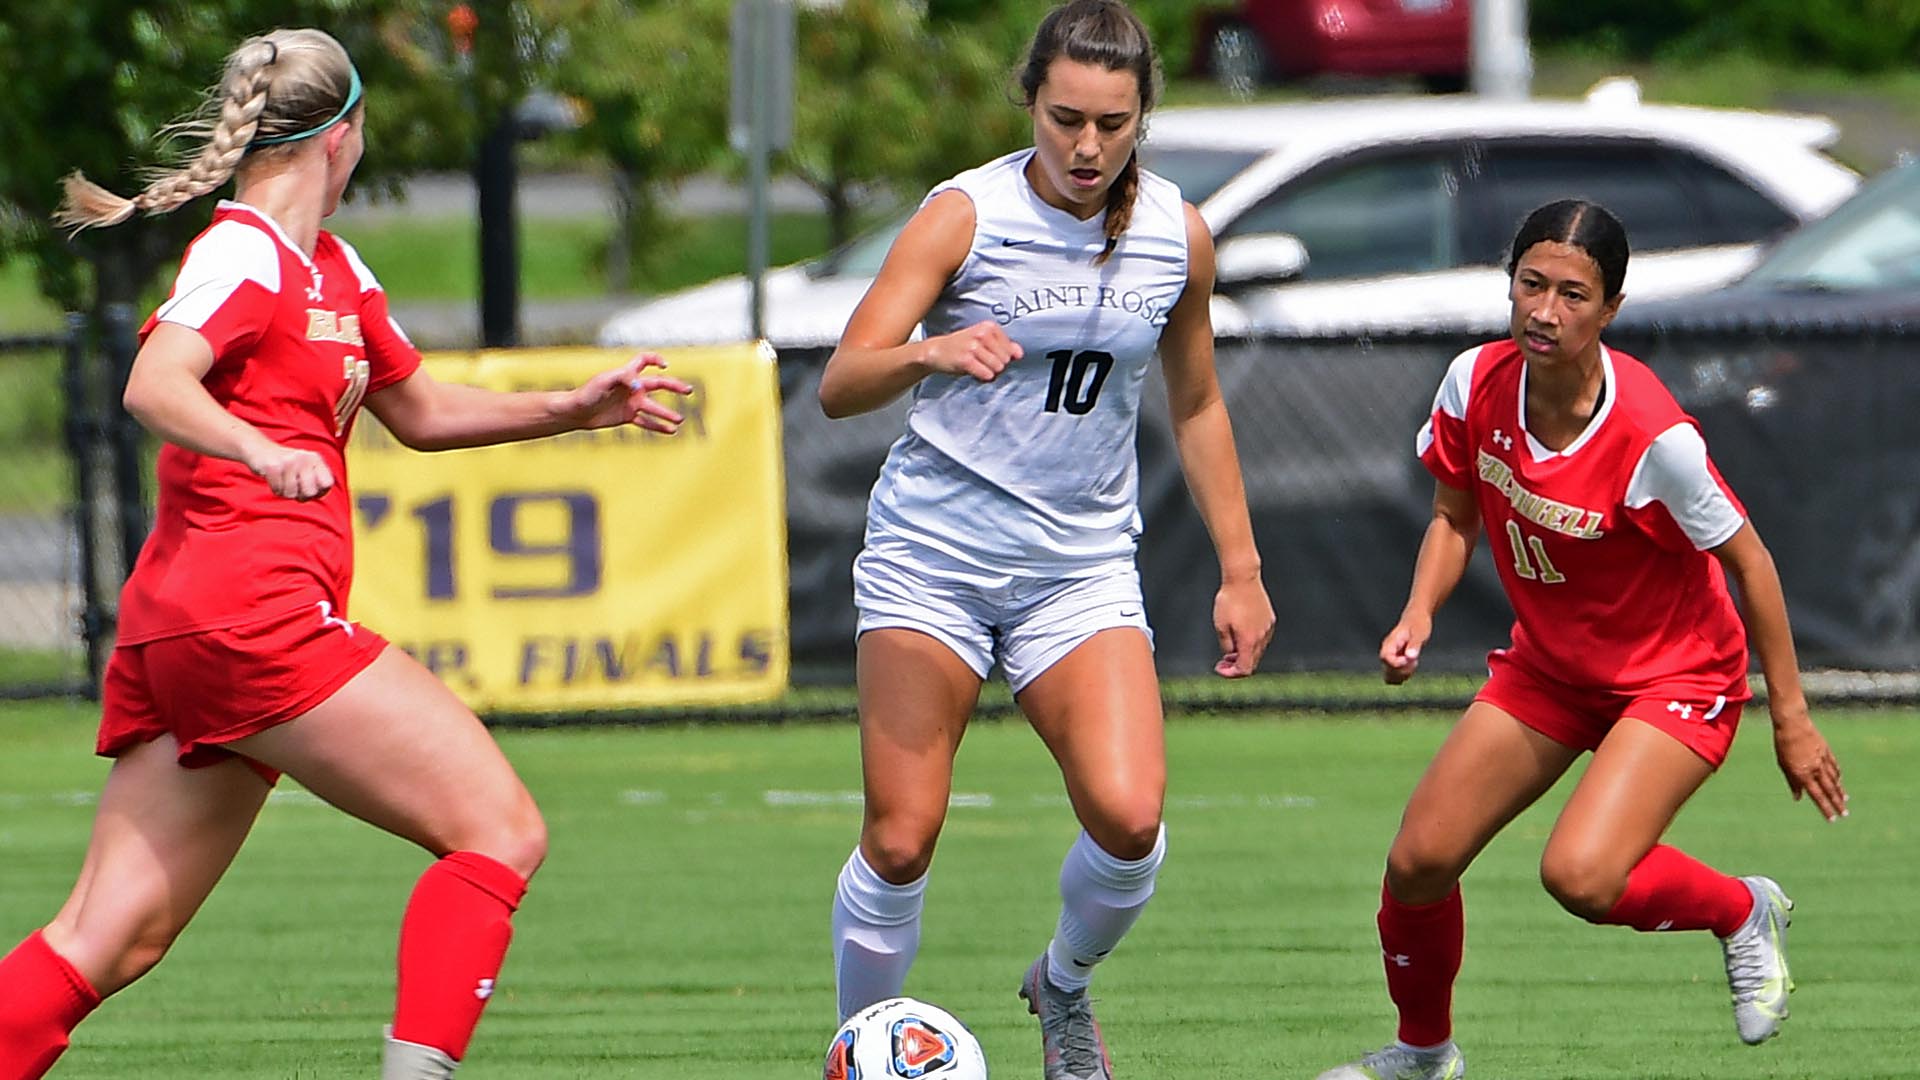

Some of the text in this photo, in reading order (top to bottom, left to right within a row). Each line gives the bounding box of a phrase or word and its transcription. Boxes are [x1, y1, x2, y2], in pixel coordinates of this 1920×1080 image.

[990, 285, 1089, 326] SAINT
[1044, 349, 1114, 415] 10
[1505, 518, 1567, 584] 11
[516, 626, 772, 686] FINALS
